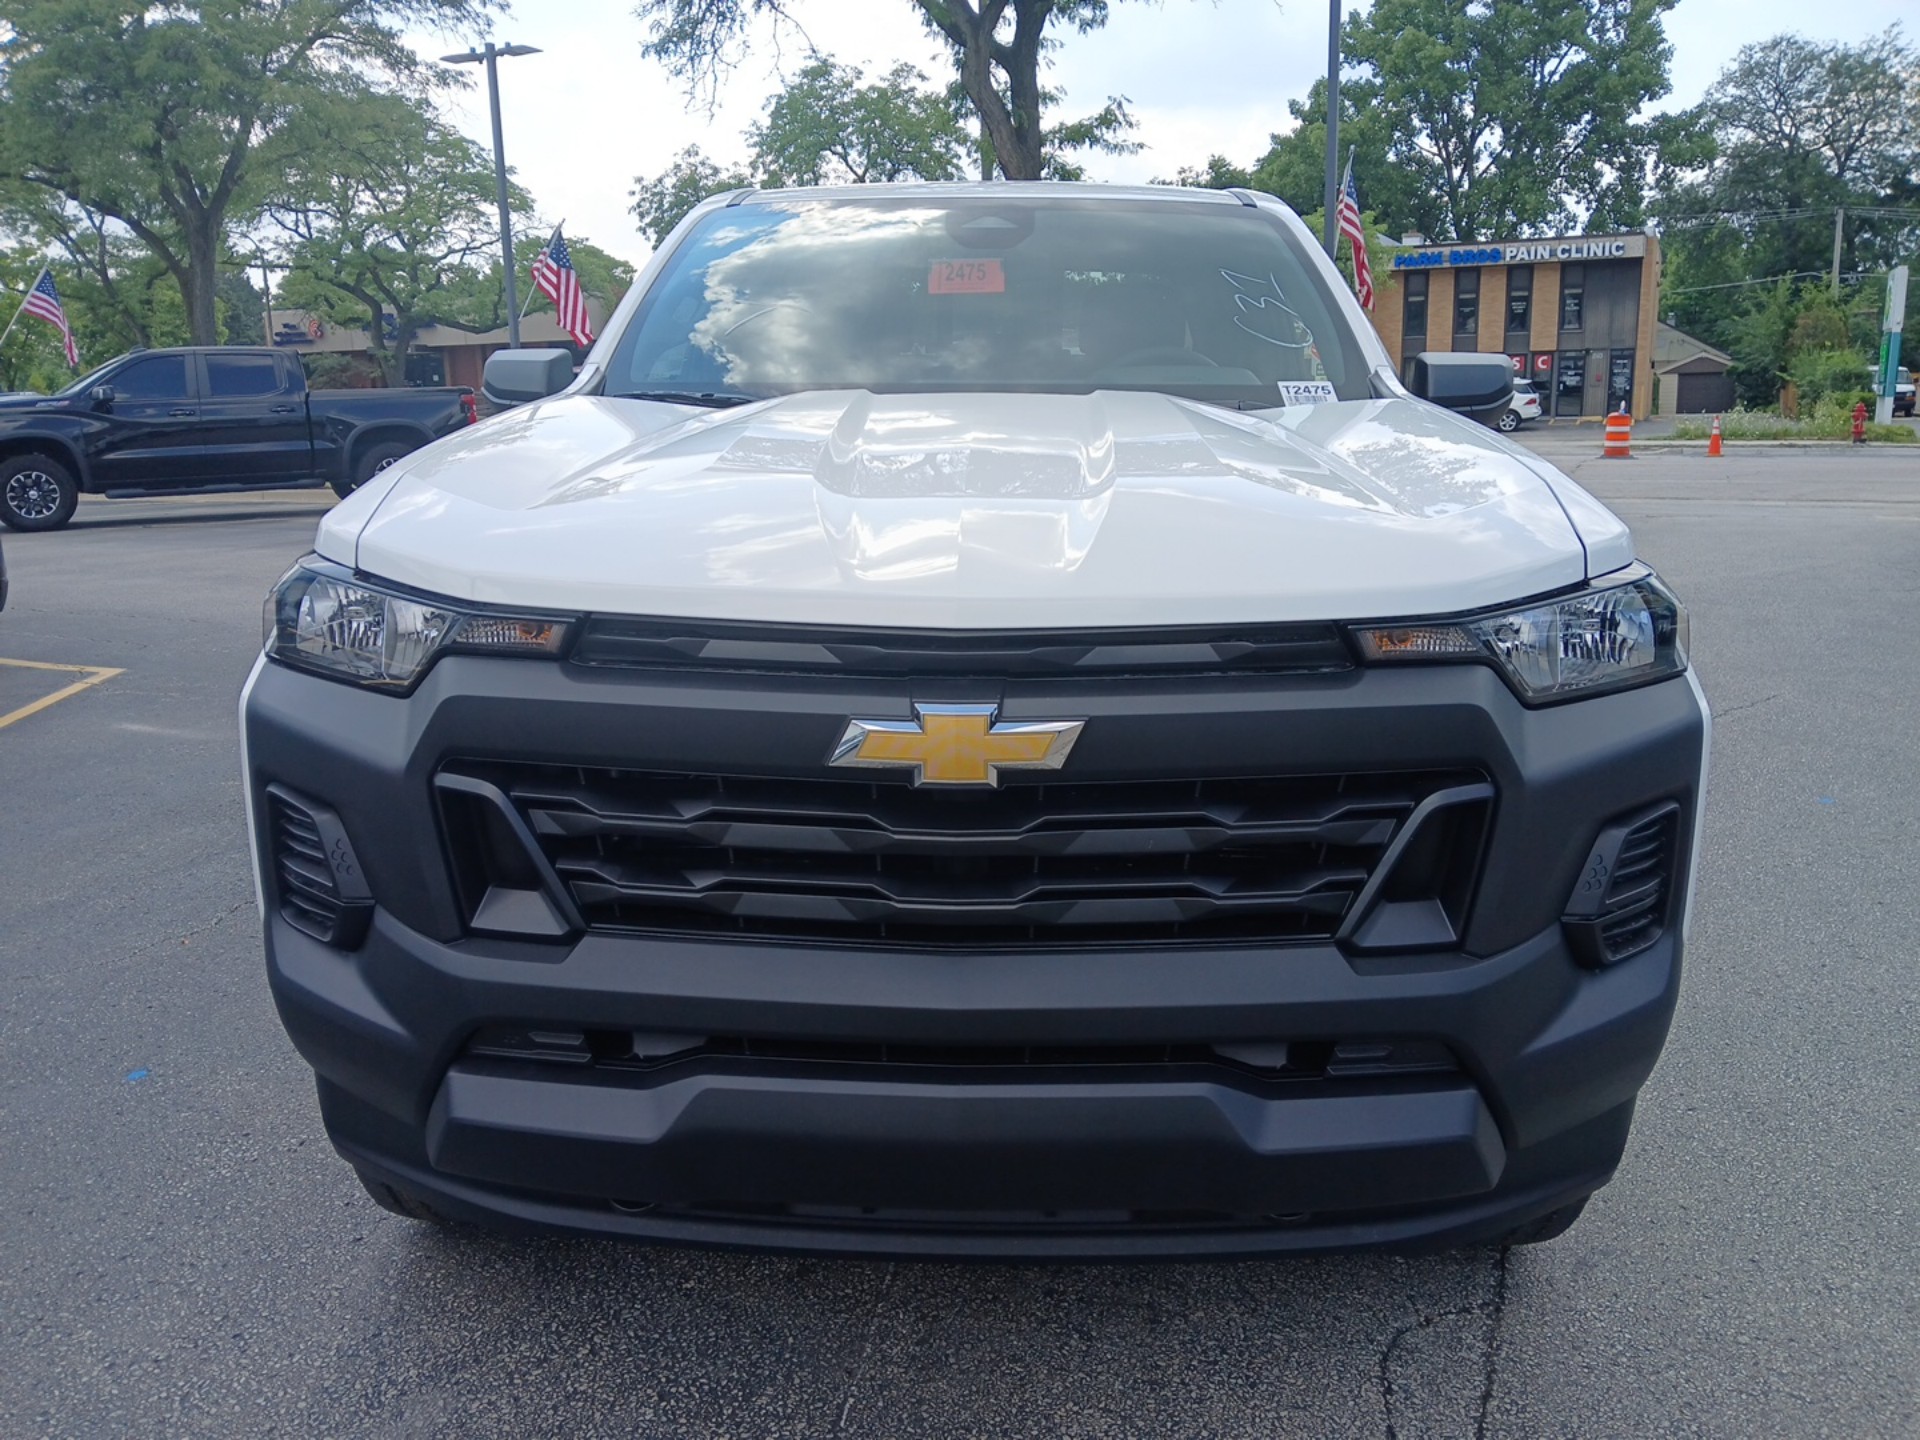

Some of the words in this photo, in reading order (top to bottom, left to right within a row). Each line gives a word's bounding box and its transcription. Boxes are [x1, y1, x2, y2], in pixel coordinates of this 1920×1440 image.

[1394, 251, 1444, 268] PARK
[1449, 247, 1501, 265] BROS
[1505, 244, 1551, 261] PAIN
[1556, 240, 1625, 258] CLINIC
[945, 262, 987, 281] 2475
[1537, 355, 1549, 369] C
[1281, 384, 1332, 396] T2475
